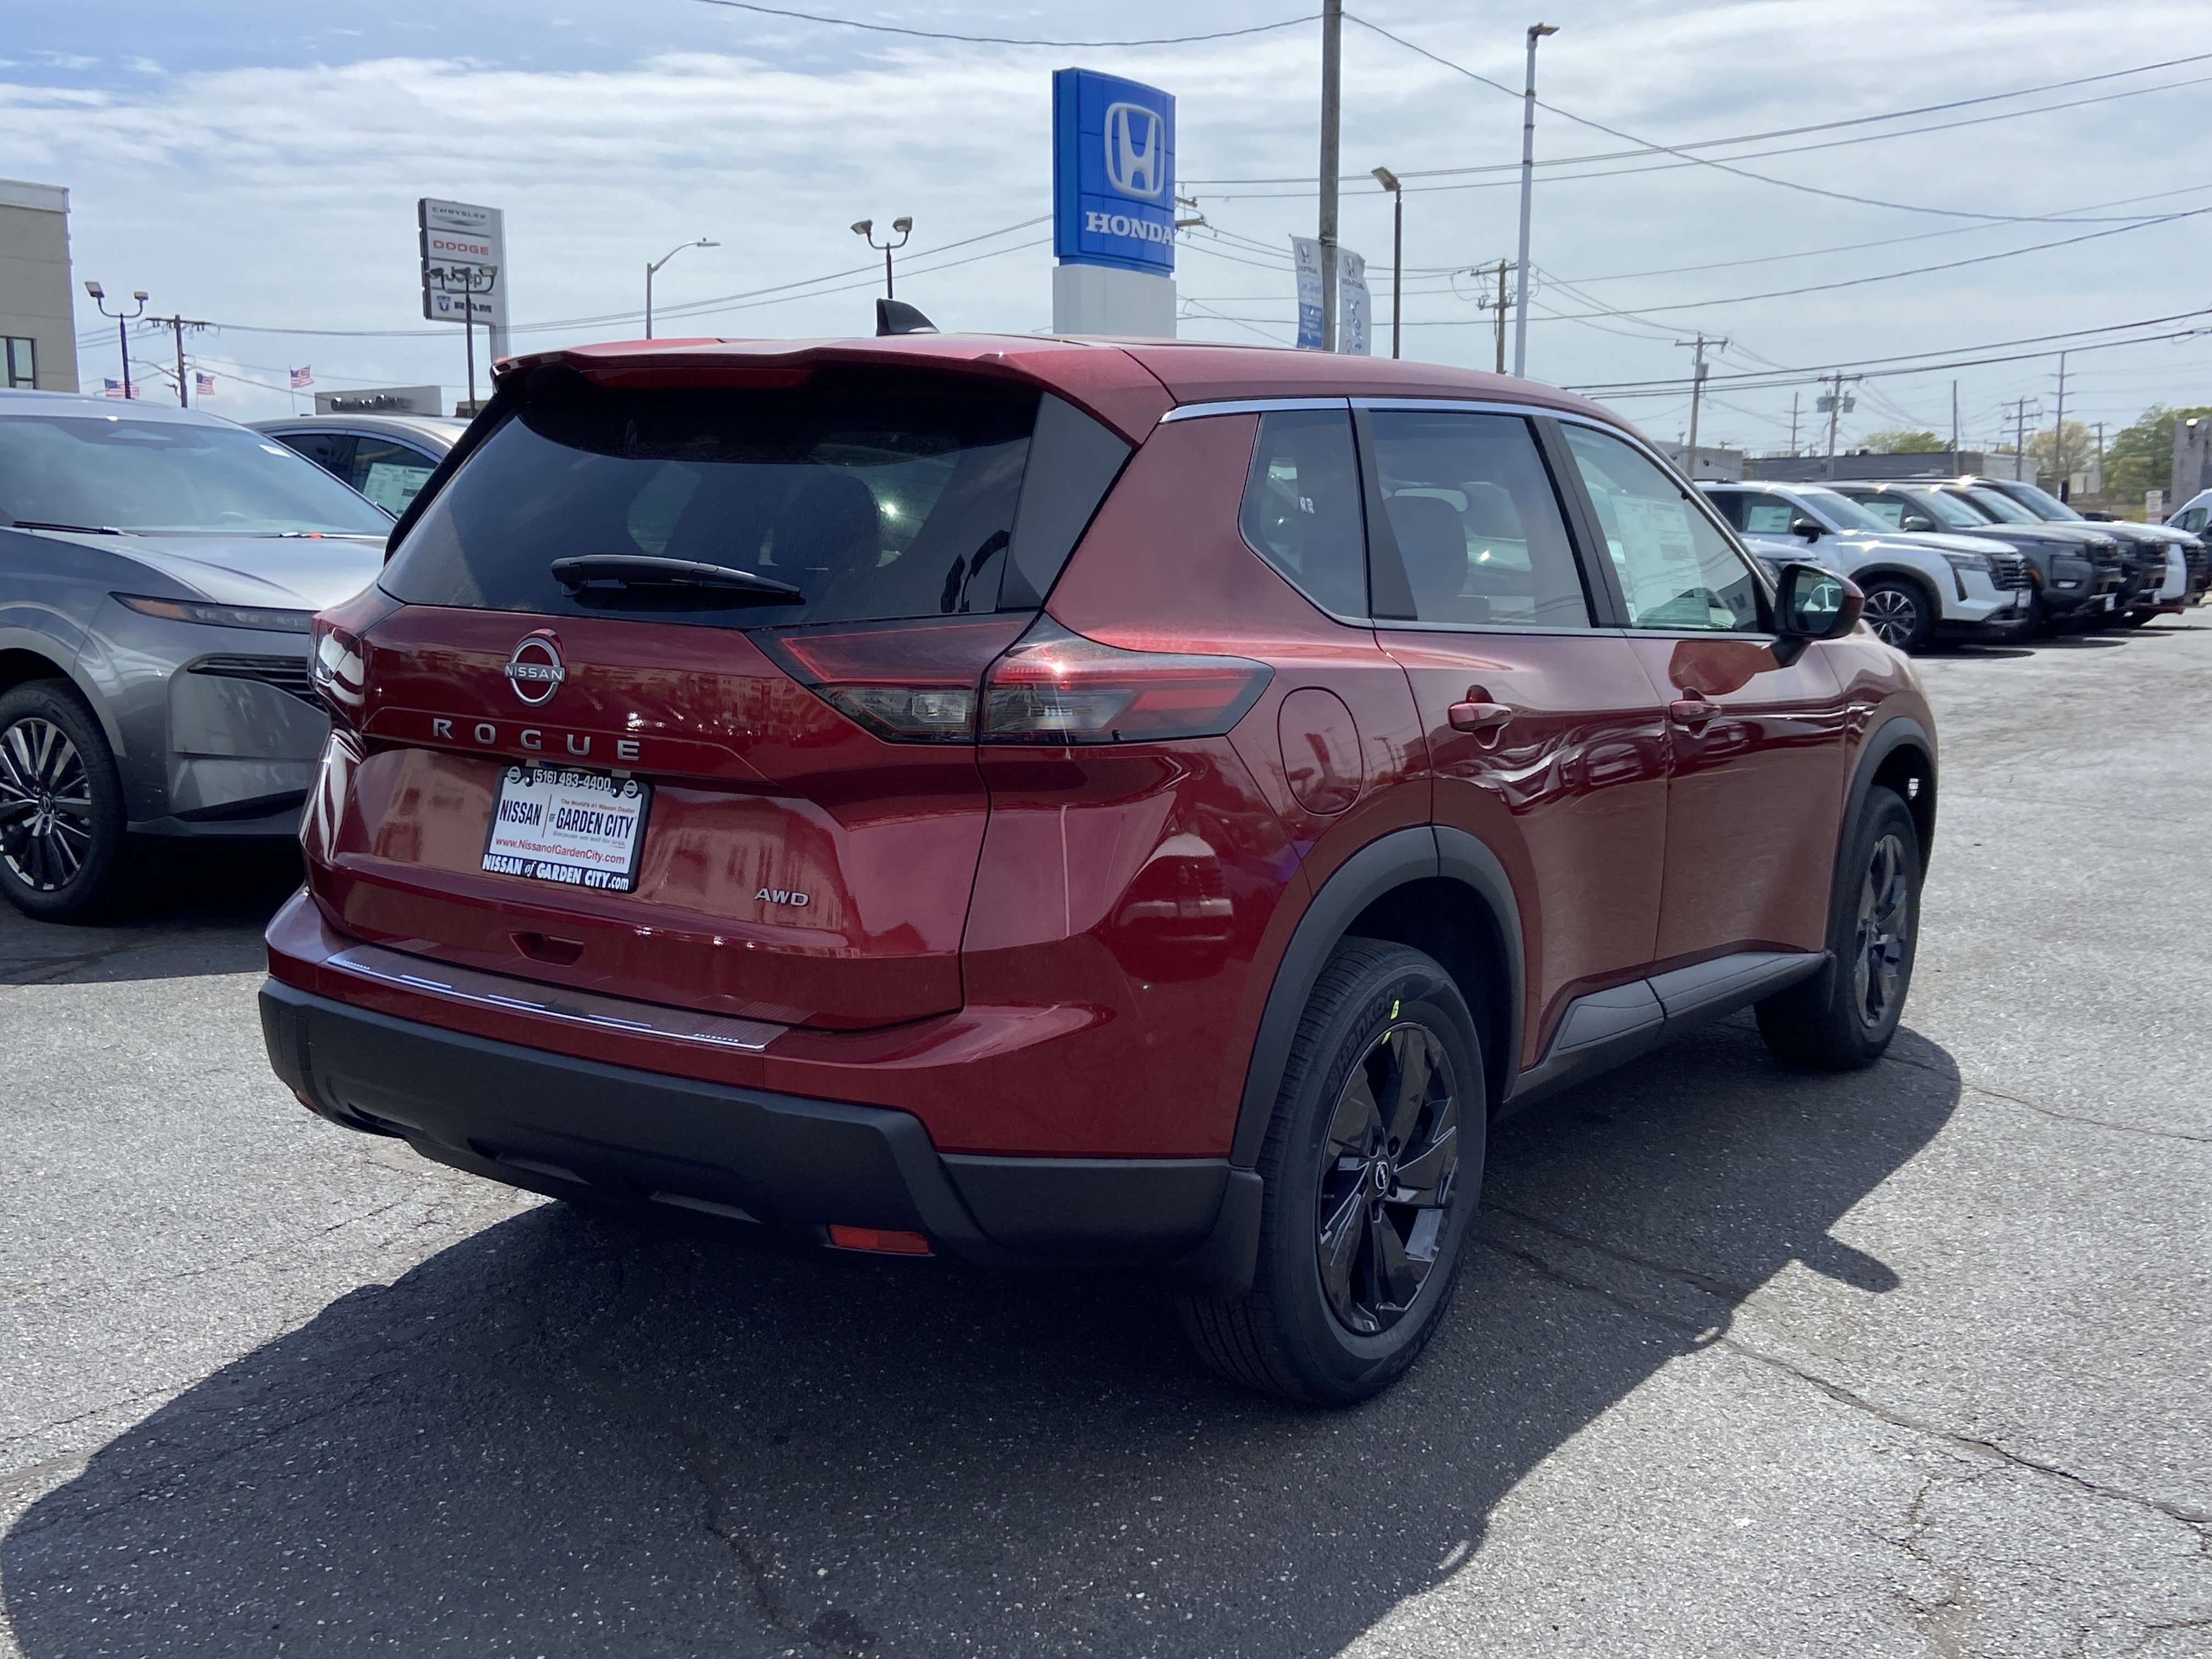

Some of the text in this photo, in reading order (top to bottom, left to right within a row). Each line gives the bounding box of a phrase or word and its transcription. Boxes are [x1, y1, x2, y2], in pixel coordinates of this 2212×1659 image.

[1085, 211, 1175, 247] HONDA
[433, 240, 489, 256] DODGE
[454, 301, 493, 313] RAM
[505, 664, 564, 681] NISSAN
[432, 718, 641, 761] ROGUE
[533, 769, 612, 792] (516) 483-4400
[499, 799, 543, 826] NISSAN
[556, 807, 603, 835] GARDEN
[605, 814, 634, 839] CITY
[618, 806, 636, 814] Dealer
[553, 830, 579, 839] Because
[495, 837, 625, 865] www.NissanofGardenCity.com
[482, 854, 629, 891] NISSAN of GARDEN CITY.com
[754, 888, 809, 906] AWD
